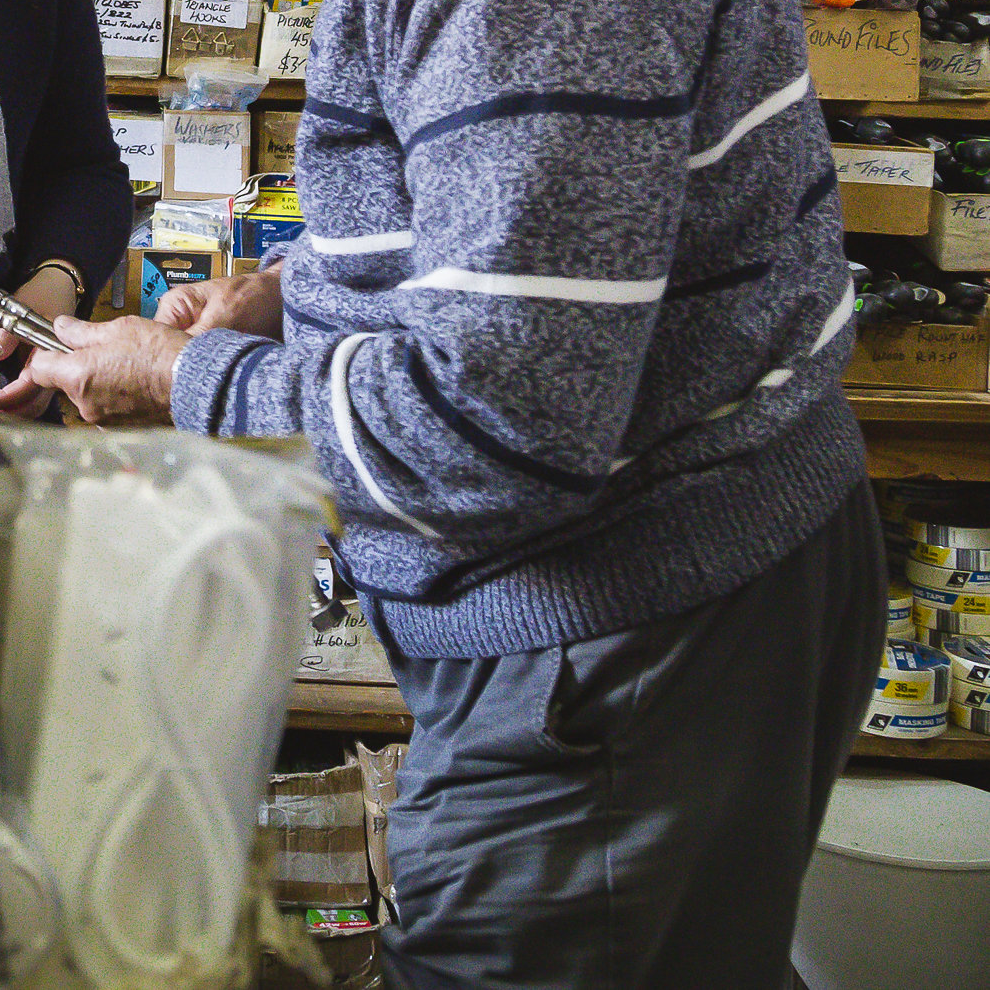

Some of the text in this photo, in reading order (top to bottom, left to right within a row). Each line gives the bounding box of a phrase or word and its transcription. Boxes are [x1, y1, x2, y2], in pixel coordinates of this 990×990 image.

[185, 0, 232, 13] TRIANGLE
[190, 13, 227, 24] HOOKS
[855, 19, 912, 56] FILES
[855, 160, 914, 182] TAPER
[964, 597, 975, 606] 24
[895, 683, 908, 692] 36
[898, 718, 933, 726] MASKING
